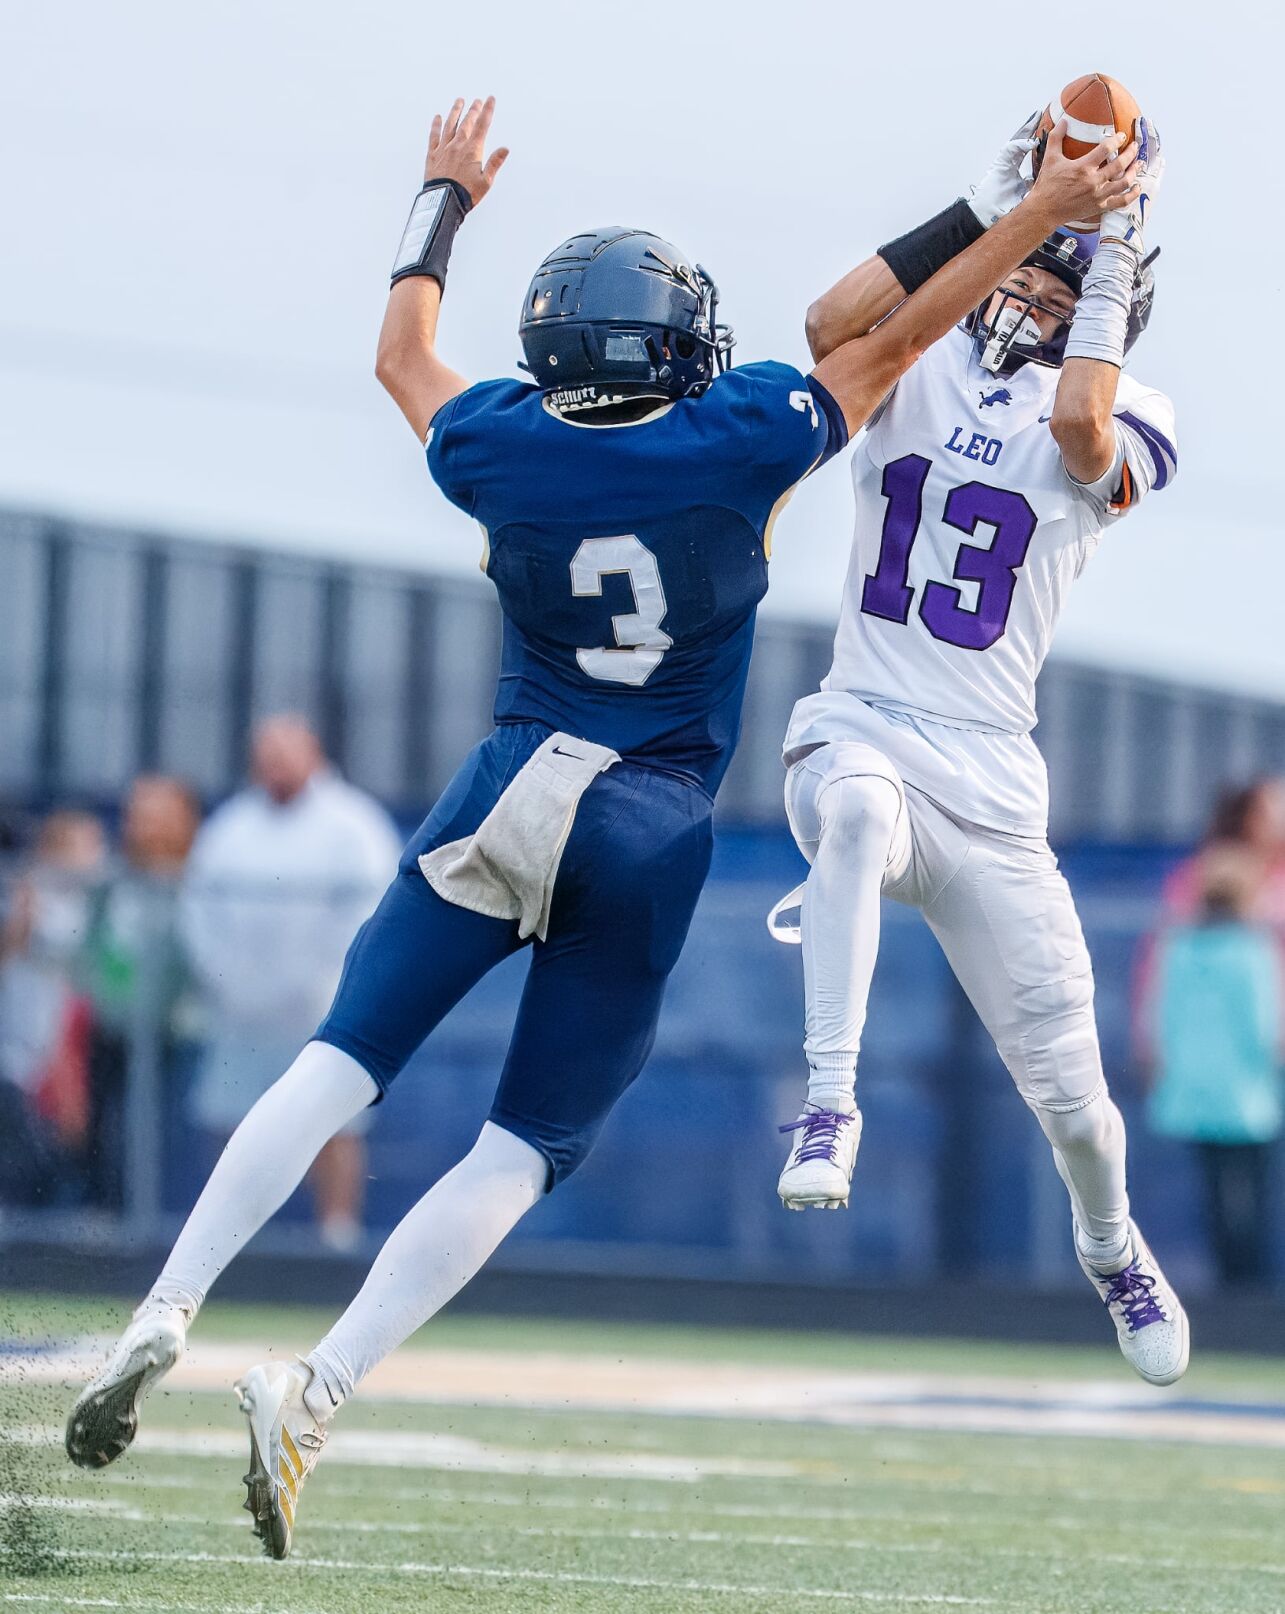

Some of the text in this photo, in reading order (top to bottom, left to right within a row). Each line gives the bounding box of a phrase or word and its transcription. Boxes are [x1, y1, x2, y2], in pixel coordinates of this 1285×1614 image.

[944, 427, 1003, 466] LEO
[569, 534, 674, 687] 3
[860, 453, 1039, 651] 13
